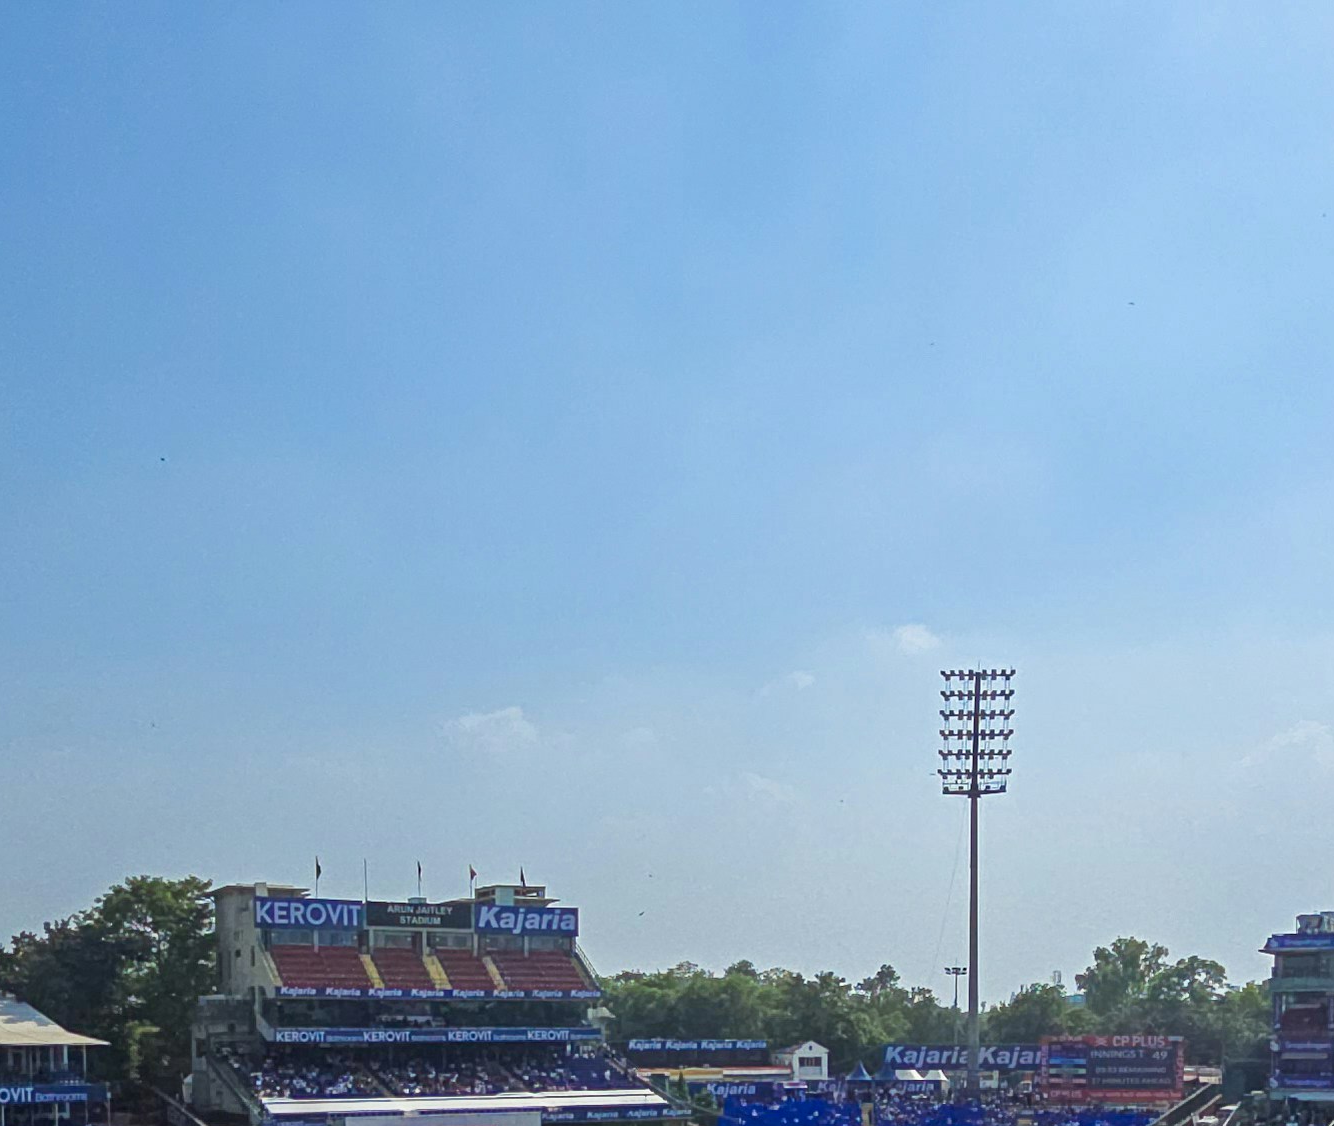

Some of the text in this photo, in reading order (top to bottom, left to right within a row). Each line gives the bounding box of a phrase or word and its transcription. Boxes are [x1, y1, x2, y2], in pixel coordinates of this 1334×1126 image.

[255, 901, 362, 927] KEROVIT
[387, 905, 454, 916] ARUN JAITLEY
[399, 915, 442, 926] STADIUM
[478, 906, 576, 934] Kajaria
[276, 1031, 325, 1043] KEROVIT
[363, 1031, 410, 1043] KEROVIT
[448, 1030, 493, 1042] KEROVIT
[527, 1030, 569, 1041] KEROVIT
[1113, 1036, 1166, 1047] CP PLUS
[979, 1046, 1042, 1069] Kajar
[706, 1083, 757, 1097] Kajaria
